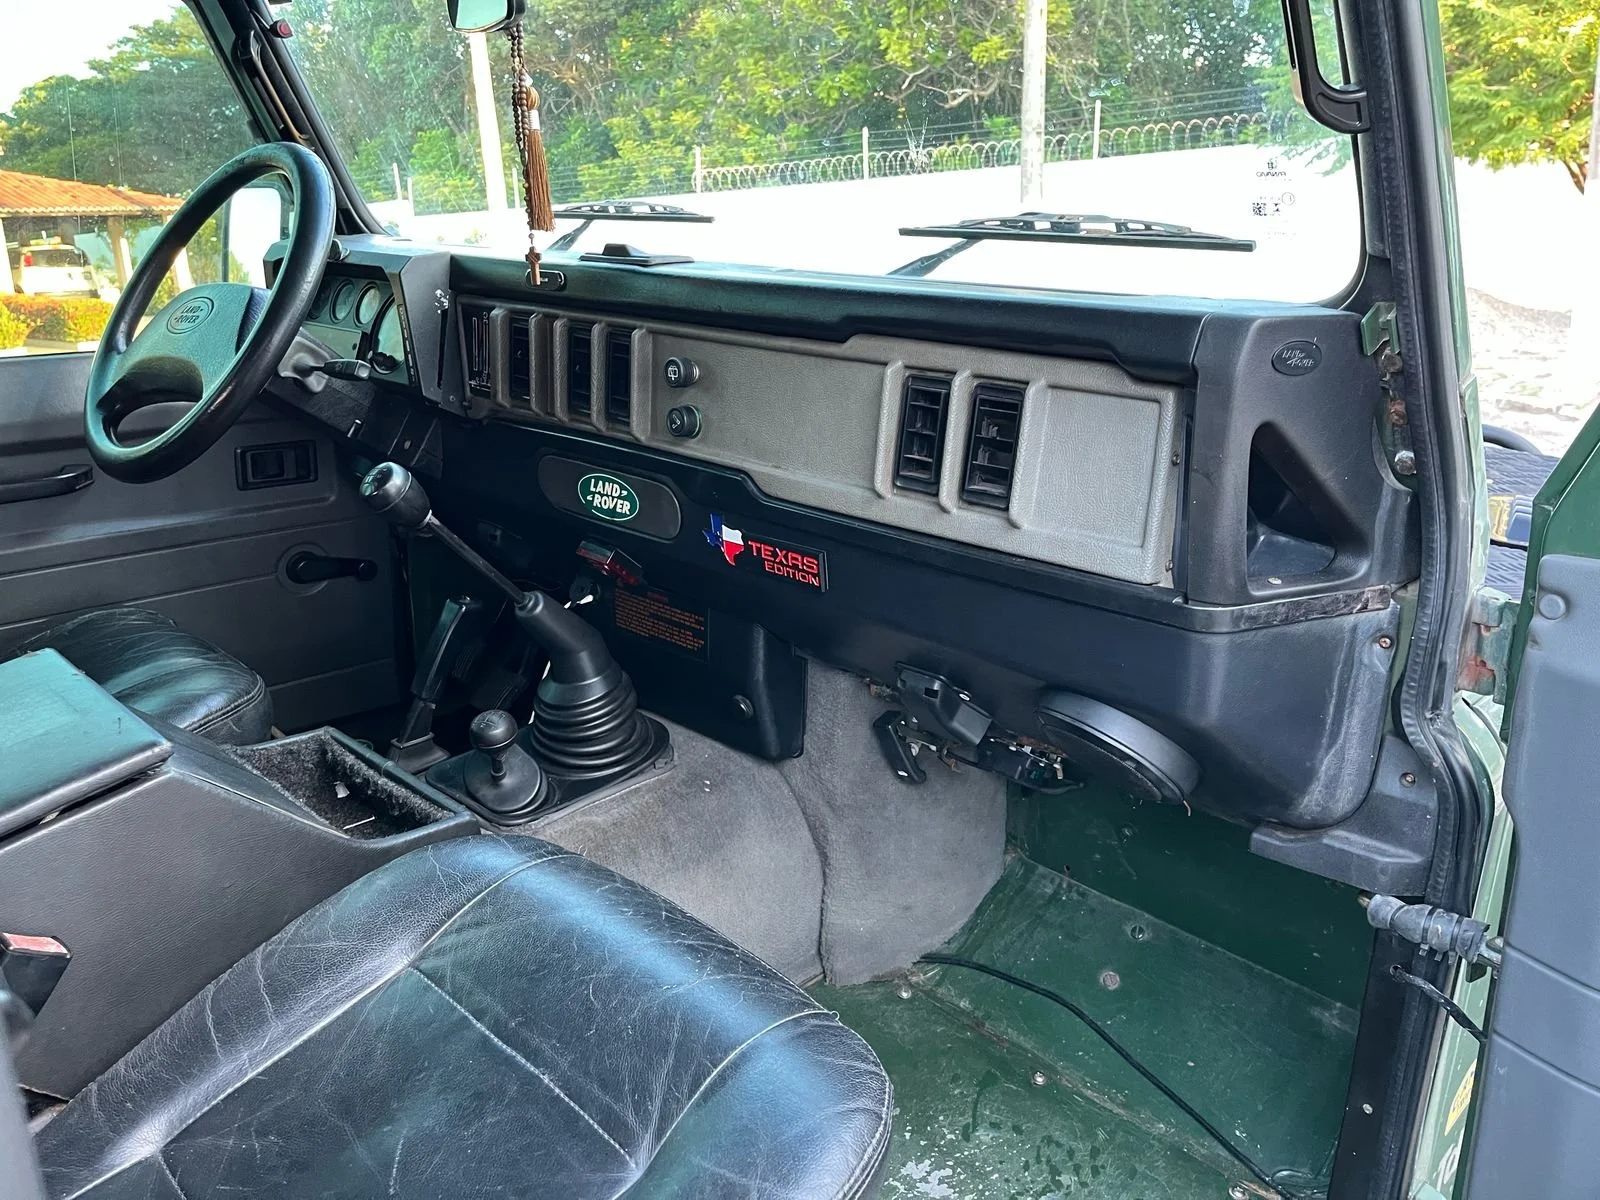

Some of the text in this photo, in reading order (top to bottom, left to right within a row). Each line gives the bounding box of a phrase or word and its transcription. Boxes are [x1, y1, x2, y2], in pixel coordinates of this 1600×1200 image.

[590, 478, 621, 497] LAND
[593, 493, 631, 515] ROVER
[748, 540, 818, 574] TEXAS
[765, 560, 820, 587] EDITION
